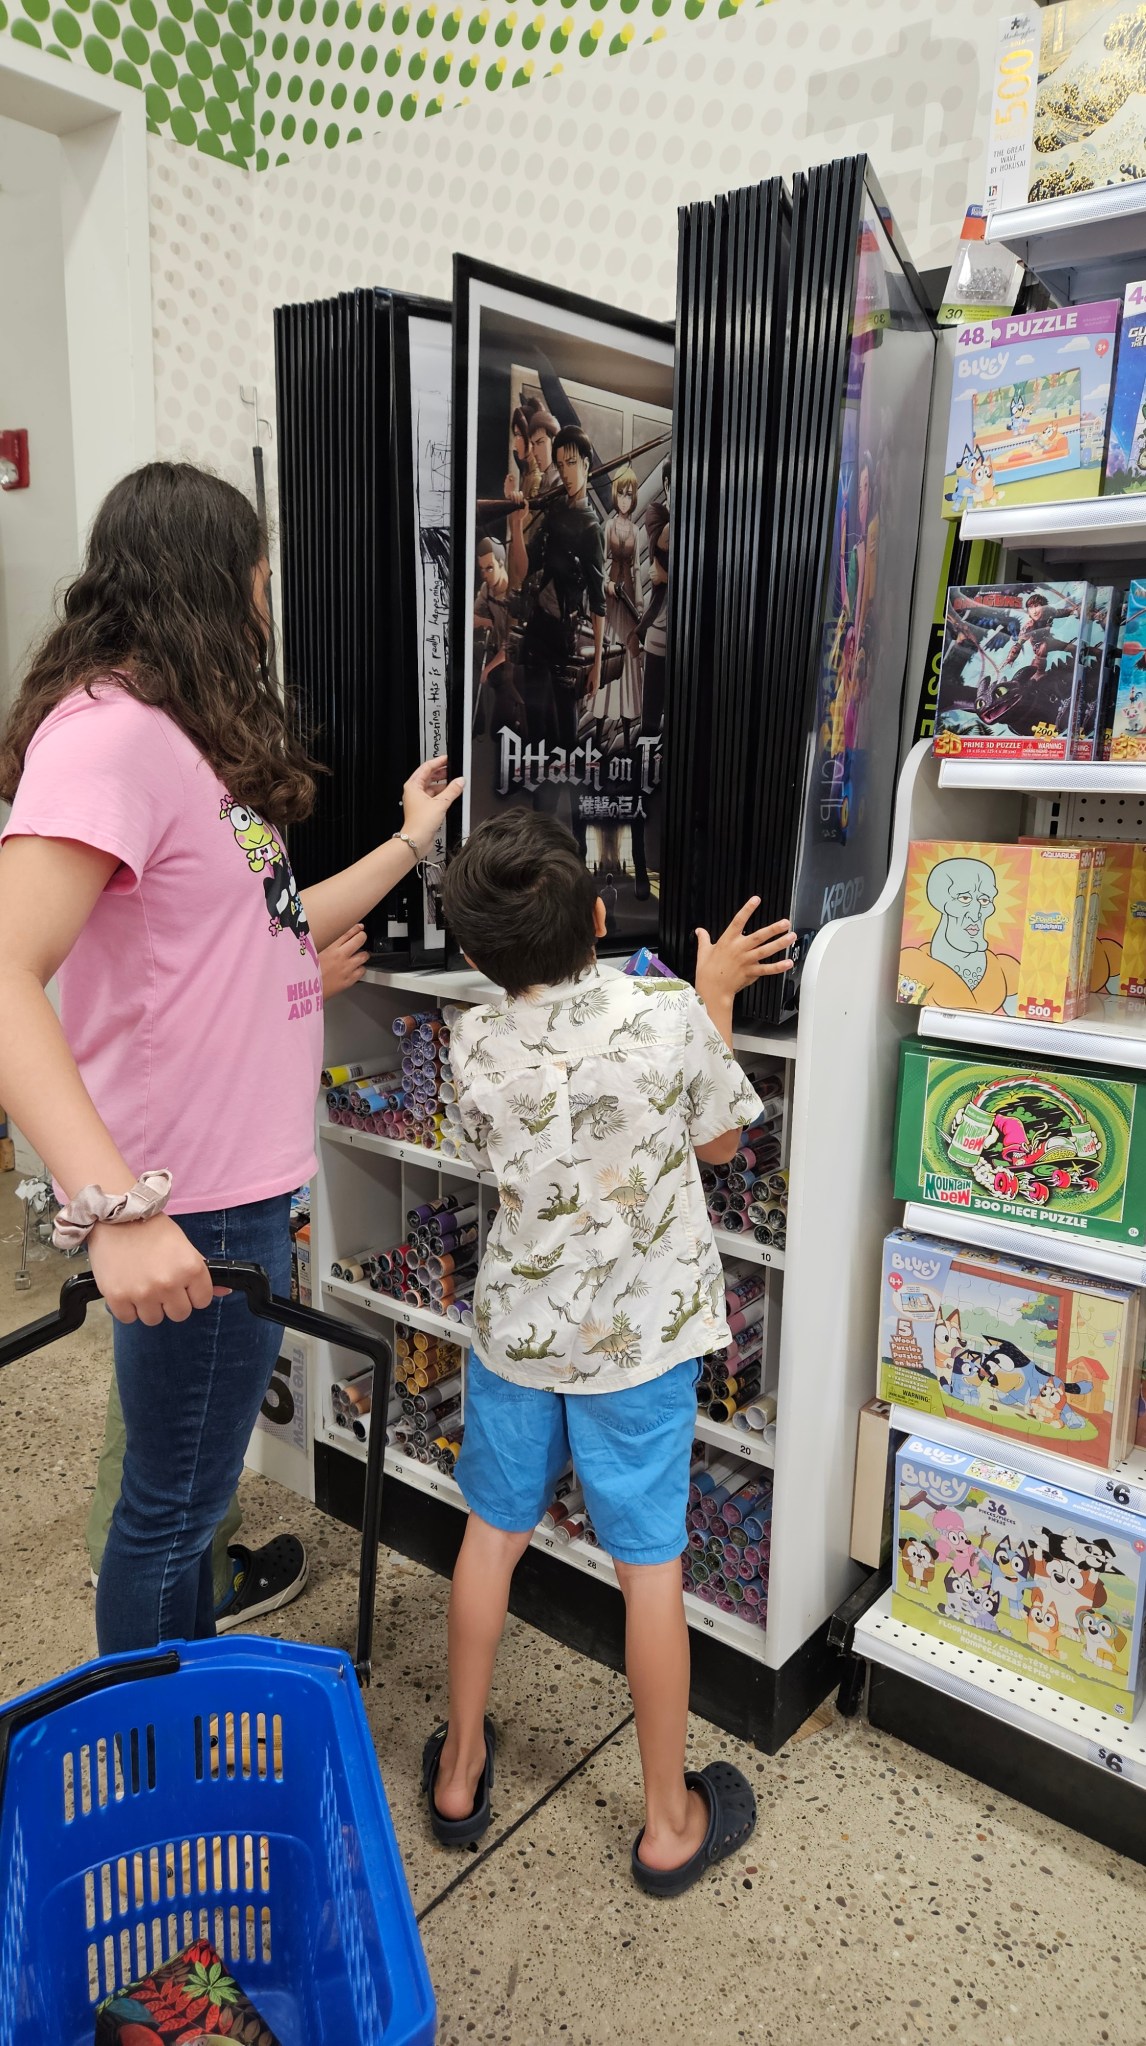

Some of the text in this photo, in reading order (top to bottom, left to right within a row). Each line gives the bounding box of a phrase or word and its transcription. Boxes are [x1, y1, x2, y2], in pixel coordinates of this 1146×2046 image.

[995, 49, 1034, 125] 500
[993, 144, 1026, 158] THE GREAT
[1000, 153, 1017, 164] WAVE
[1128, 287, 1146, 305] 4
[945, 308, 963, 319] 30
[1005, 312, 1078, 340] PUZZLE
[958, 327, 985, 346] 48
[427, 681, 440, 703] this
[1036, 728, 1053, 737] 200
[496, 725, 603, 795] Attack
[608, 756, 633, 781] on
[579, 795, 647, 820] 進撃の巨人
[1042, 851, 1077, 859] AQUARIUS
[287, 977, 320, 1002] HELLO
[288, 999, 312, 1020] AND
[1028, 1005, 1051, 1017] 500
[974, 1199, 1088, 1228] 300 PIECE PUZZLE
[761, 1252, 771, 1262] 10
[892, 1252, 941, 1280] BLUEY
[889, 1276, 902, 1286] 4+
[327, 1285, 333, 1293] 11
[365, 1299, 371, 1308] 12
[403, 1314, 410, 1322] 13
[444, 1330, 451, 1338] 14
[898, 1320, 912, 1336] 5
[893, 1336, 916, 1345] Wood
[328, 1433, 335, 1441] 21
[740, 1444, 751, 1455] 20
[908, 1441, 967, 1466] BLUEY
[395, 1465, 403, 1474] 23
[430, 1482, 438, 1491] 24
[901, 1463, 967, 1502] BLUEY
[1106, 1480, 1131, 1505] $6
[988, 1500, 1007, 1516] 36
[545, 1538, 554, 1548] 27
[587, 1559, 597, 1570] 28
[703, 1617, 714, 1628] 30
[963, 1629, 993, 1647] PUZZLE
[1098, 1748, 1123, 1773] $6
